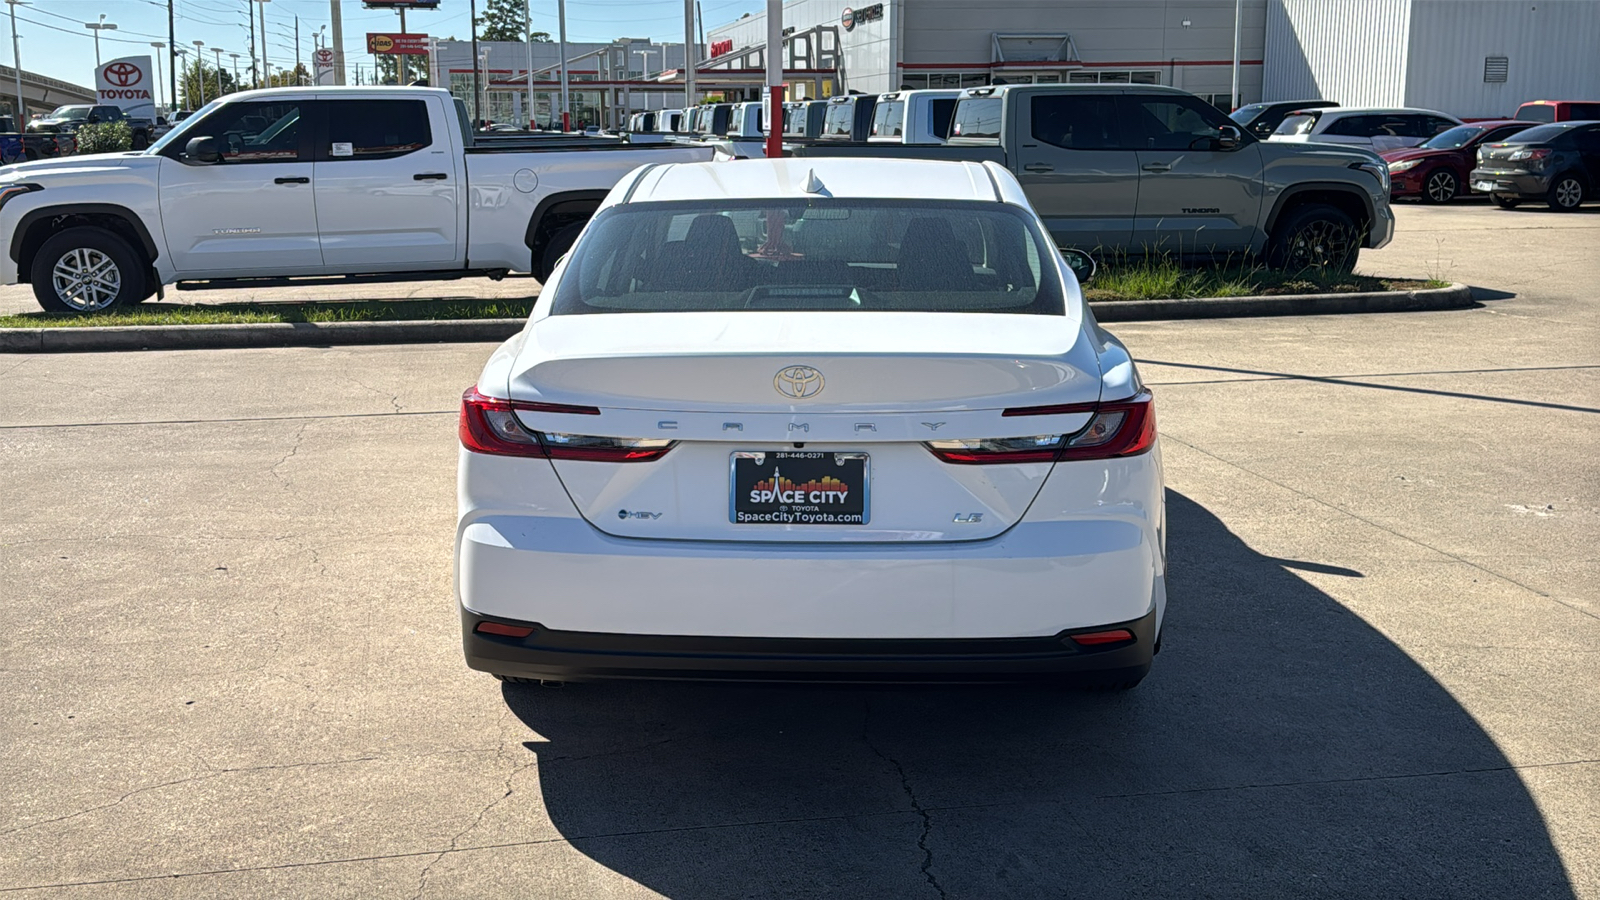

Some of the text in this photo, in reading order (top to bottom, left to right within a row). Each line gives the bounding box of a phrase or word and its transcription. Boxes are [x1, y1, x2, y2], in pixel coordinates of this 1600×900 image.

[98, 89, 151, 99] TOYOTA
[212, 226, 261, 235] TUNDRA
[657, 420, 946, 433] CAMRY
[750, 490, 848, 503] SPACE CITY
[737, 511, 862, 523] SpaceCityToyota.com
[952, 512, 984, 523] LE
